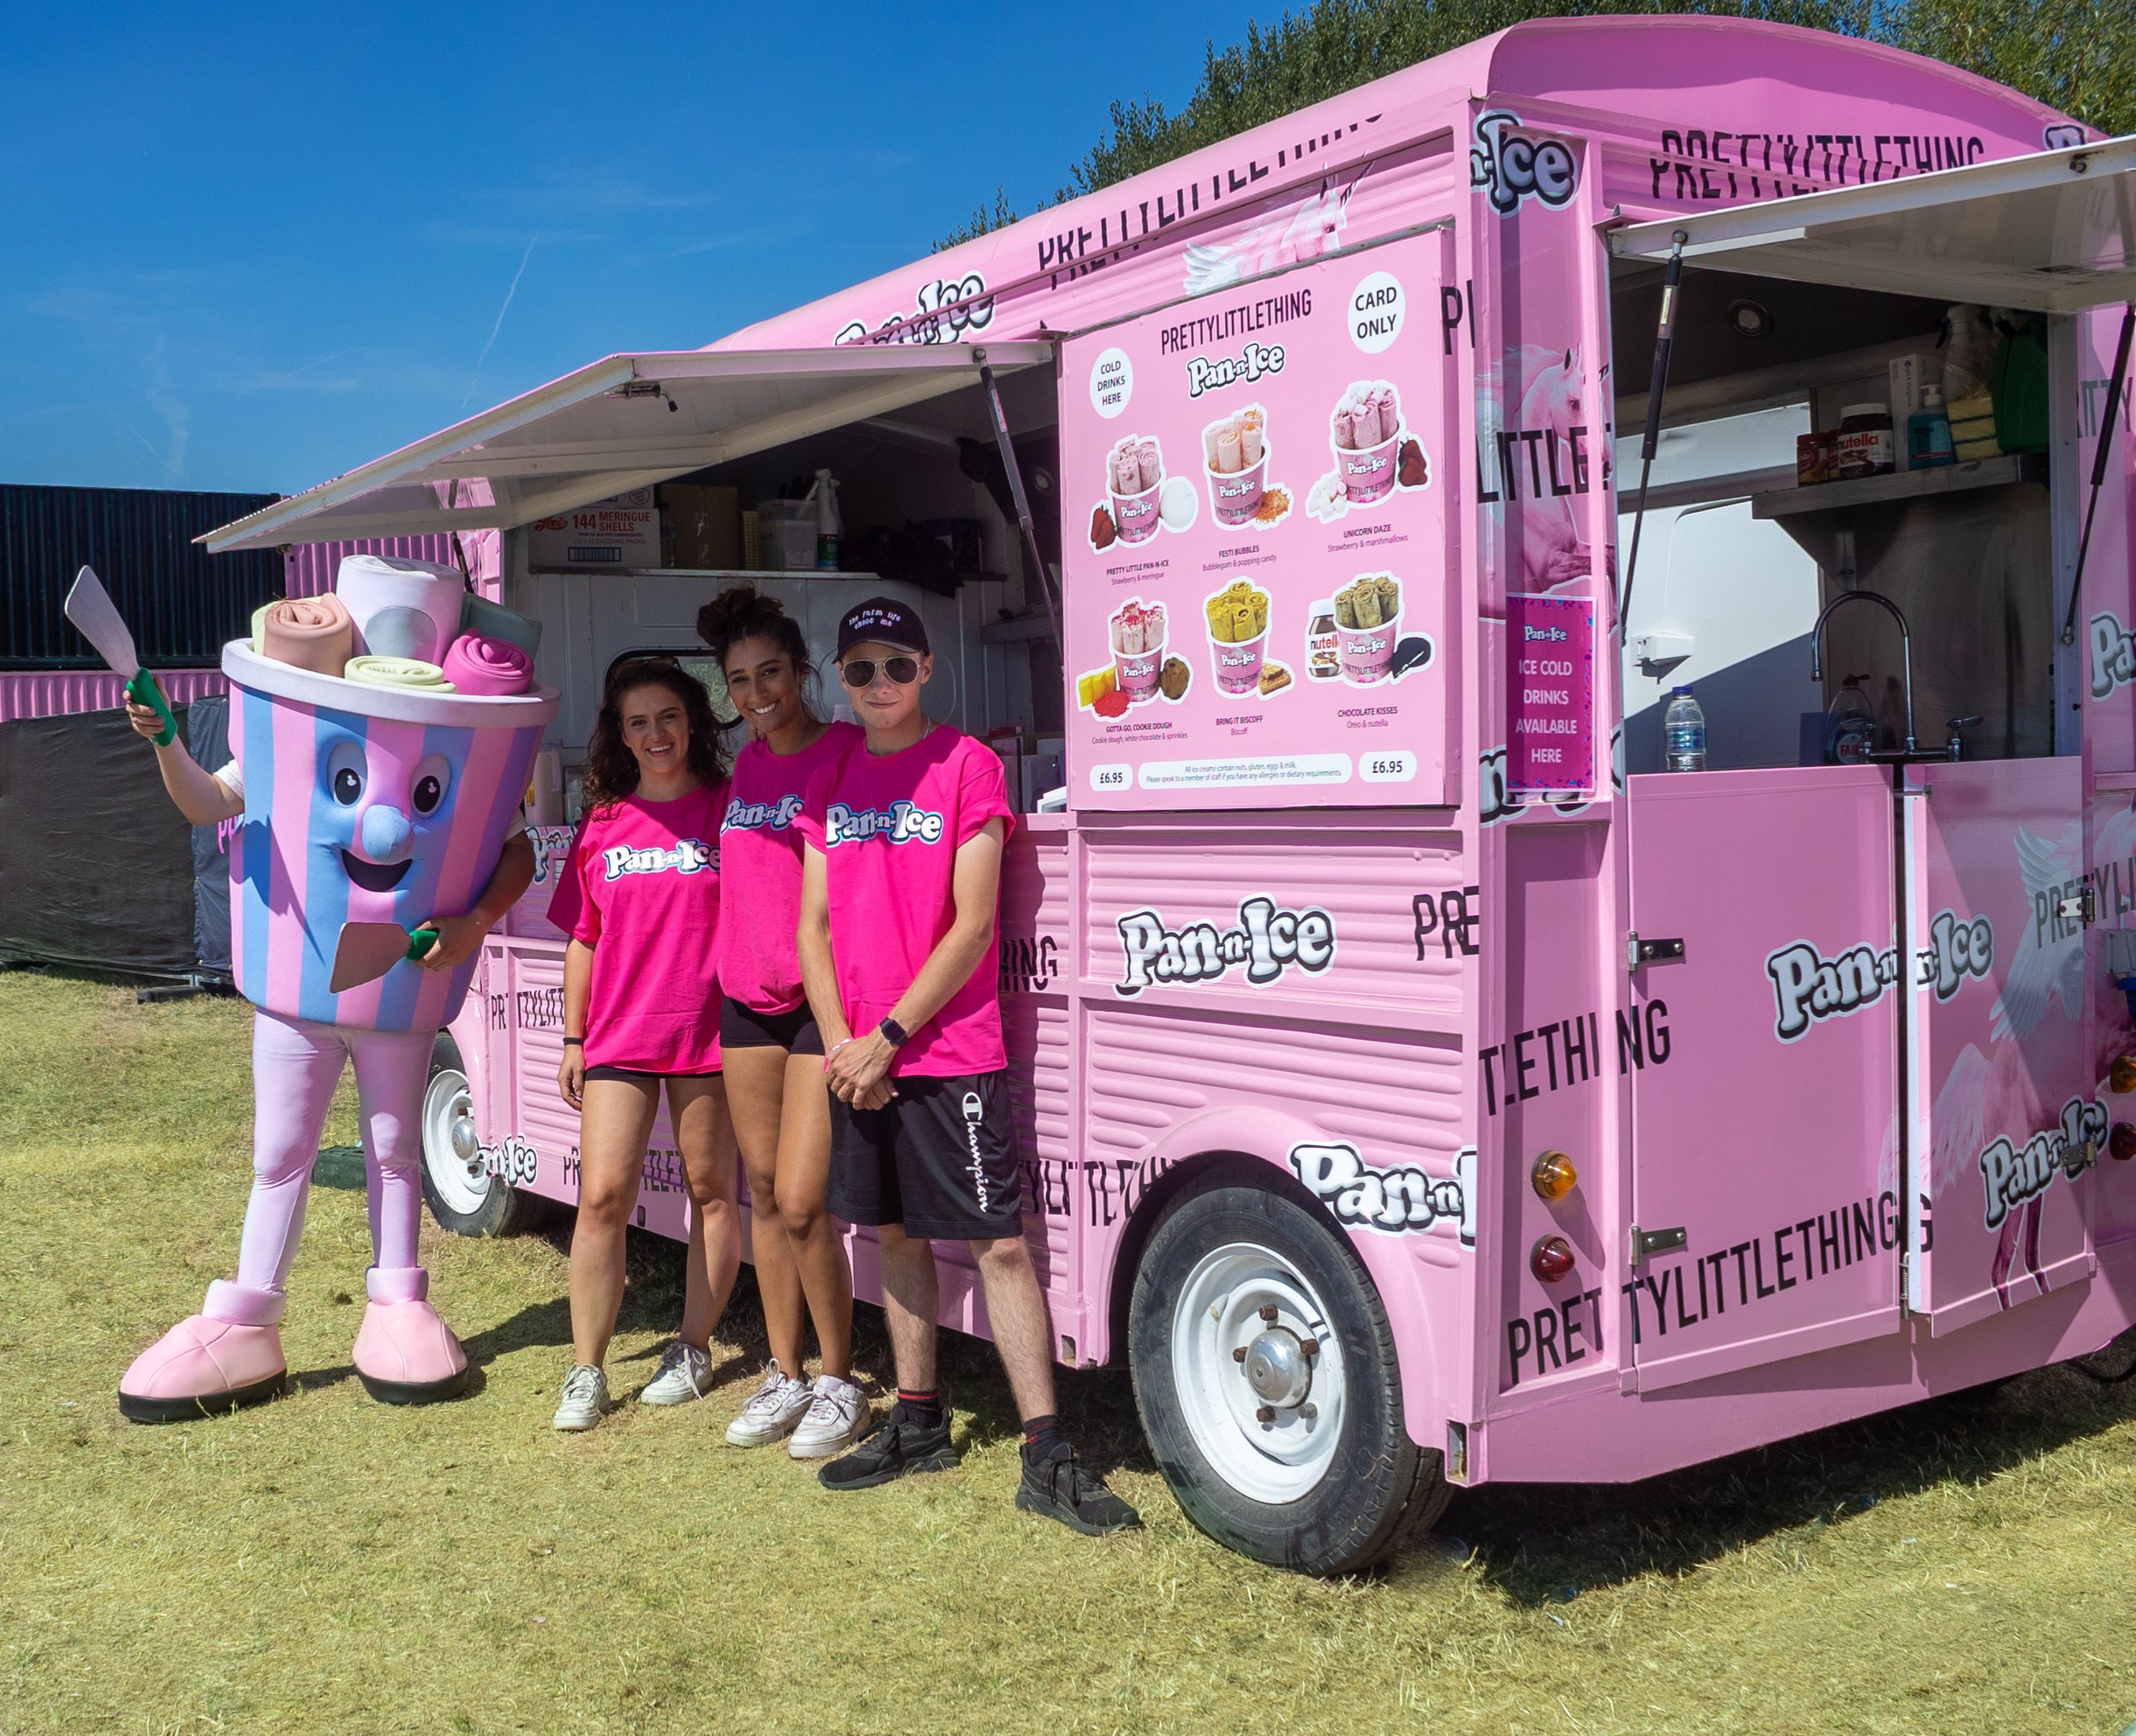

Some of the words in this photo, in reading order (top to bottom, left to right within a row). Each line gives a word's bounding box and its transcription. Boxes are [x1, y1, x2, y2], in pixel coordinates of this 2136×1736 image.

[1354, 286, 1398, 312] CARD
[1161, 288, 1312, 355] PRETTYLITTLETHING
[1356, 314, 1398, 340] ONLY
[1100, 360, 1122, 375] COLD
[1097, 375, 1126, 392] DRINKS
[1102, 392, 1122, 407] HERE
[573, 514, 597, 529] 144
[599, 511, 651, 522] MERINGUE
[599, 522, 634, 532] SHELLS
[1343, 527, 1372, 538] UNICORN
[1373, 524, 1391, 534] DAZE
[1234, 546, 1259, 556] BUBBLES
[1106, 567, 1125, 575] PRETTY
[1126, 564, 1142, 573] LITTLE
[1311, 634, 1339, 650] nutell
[1519, 659, 1538, 675] ICE
[1541, 660, 1573, 675] COLD
[1524, 689, 1569, 705] DRINKS
[1337, 707, 1375, 717] CHOCOLATE
[1376, 706, 1398, 715] KISSES
[1133, 722, 1152, 732] COOKIE
[1153, 722, 1172, 730] DOUGH
[1216, 717, 1233, 726] BRING
[1240, 715, 1264, 724] BISCOFF
[1347, 720, 1361, 728] Oreo
[1515, 718, 1577, 734] AVAILABLE
[1230, 728, 1248, 736] Biscoff
[1531, 748, 1562, 764] HERE
[1372, 760, 1402, 774] £6.95
[1099, 772, 1123, 784] £6.95
[721, 796, 804, 833] Pan-n-Ic
[1116, 897, 1335, 996] Pan-n-Ice
[961, 1091, 988, 1212] Champion
